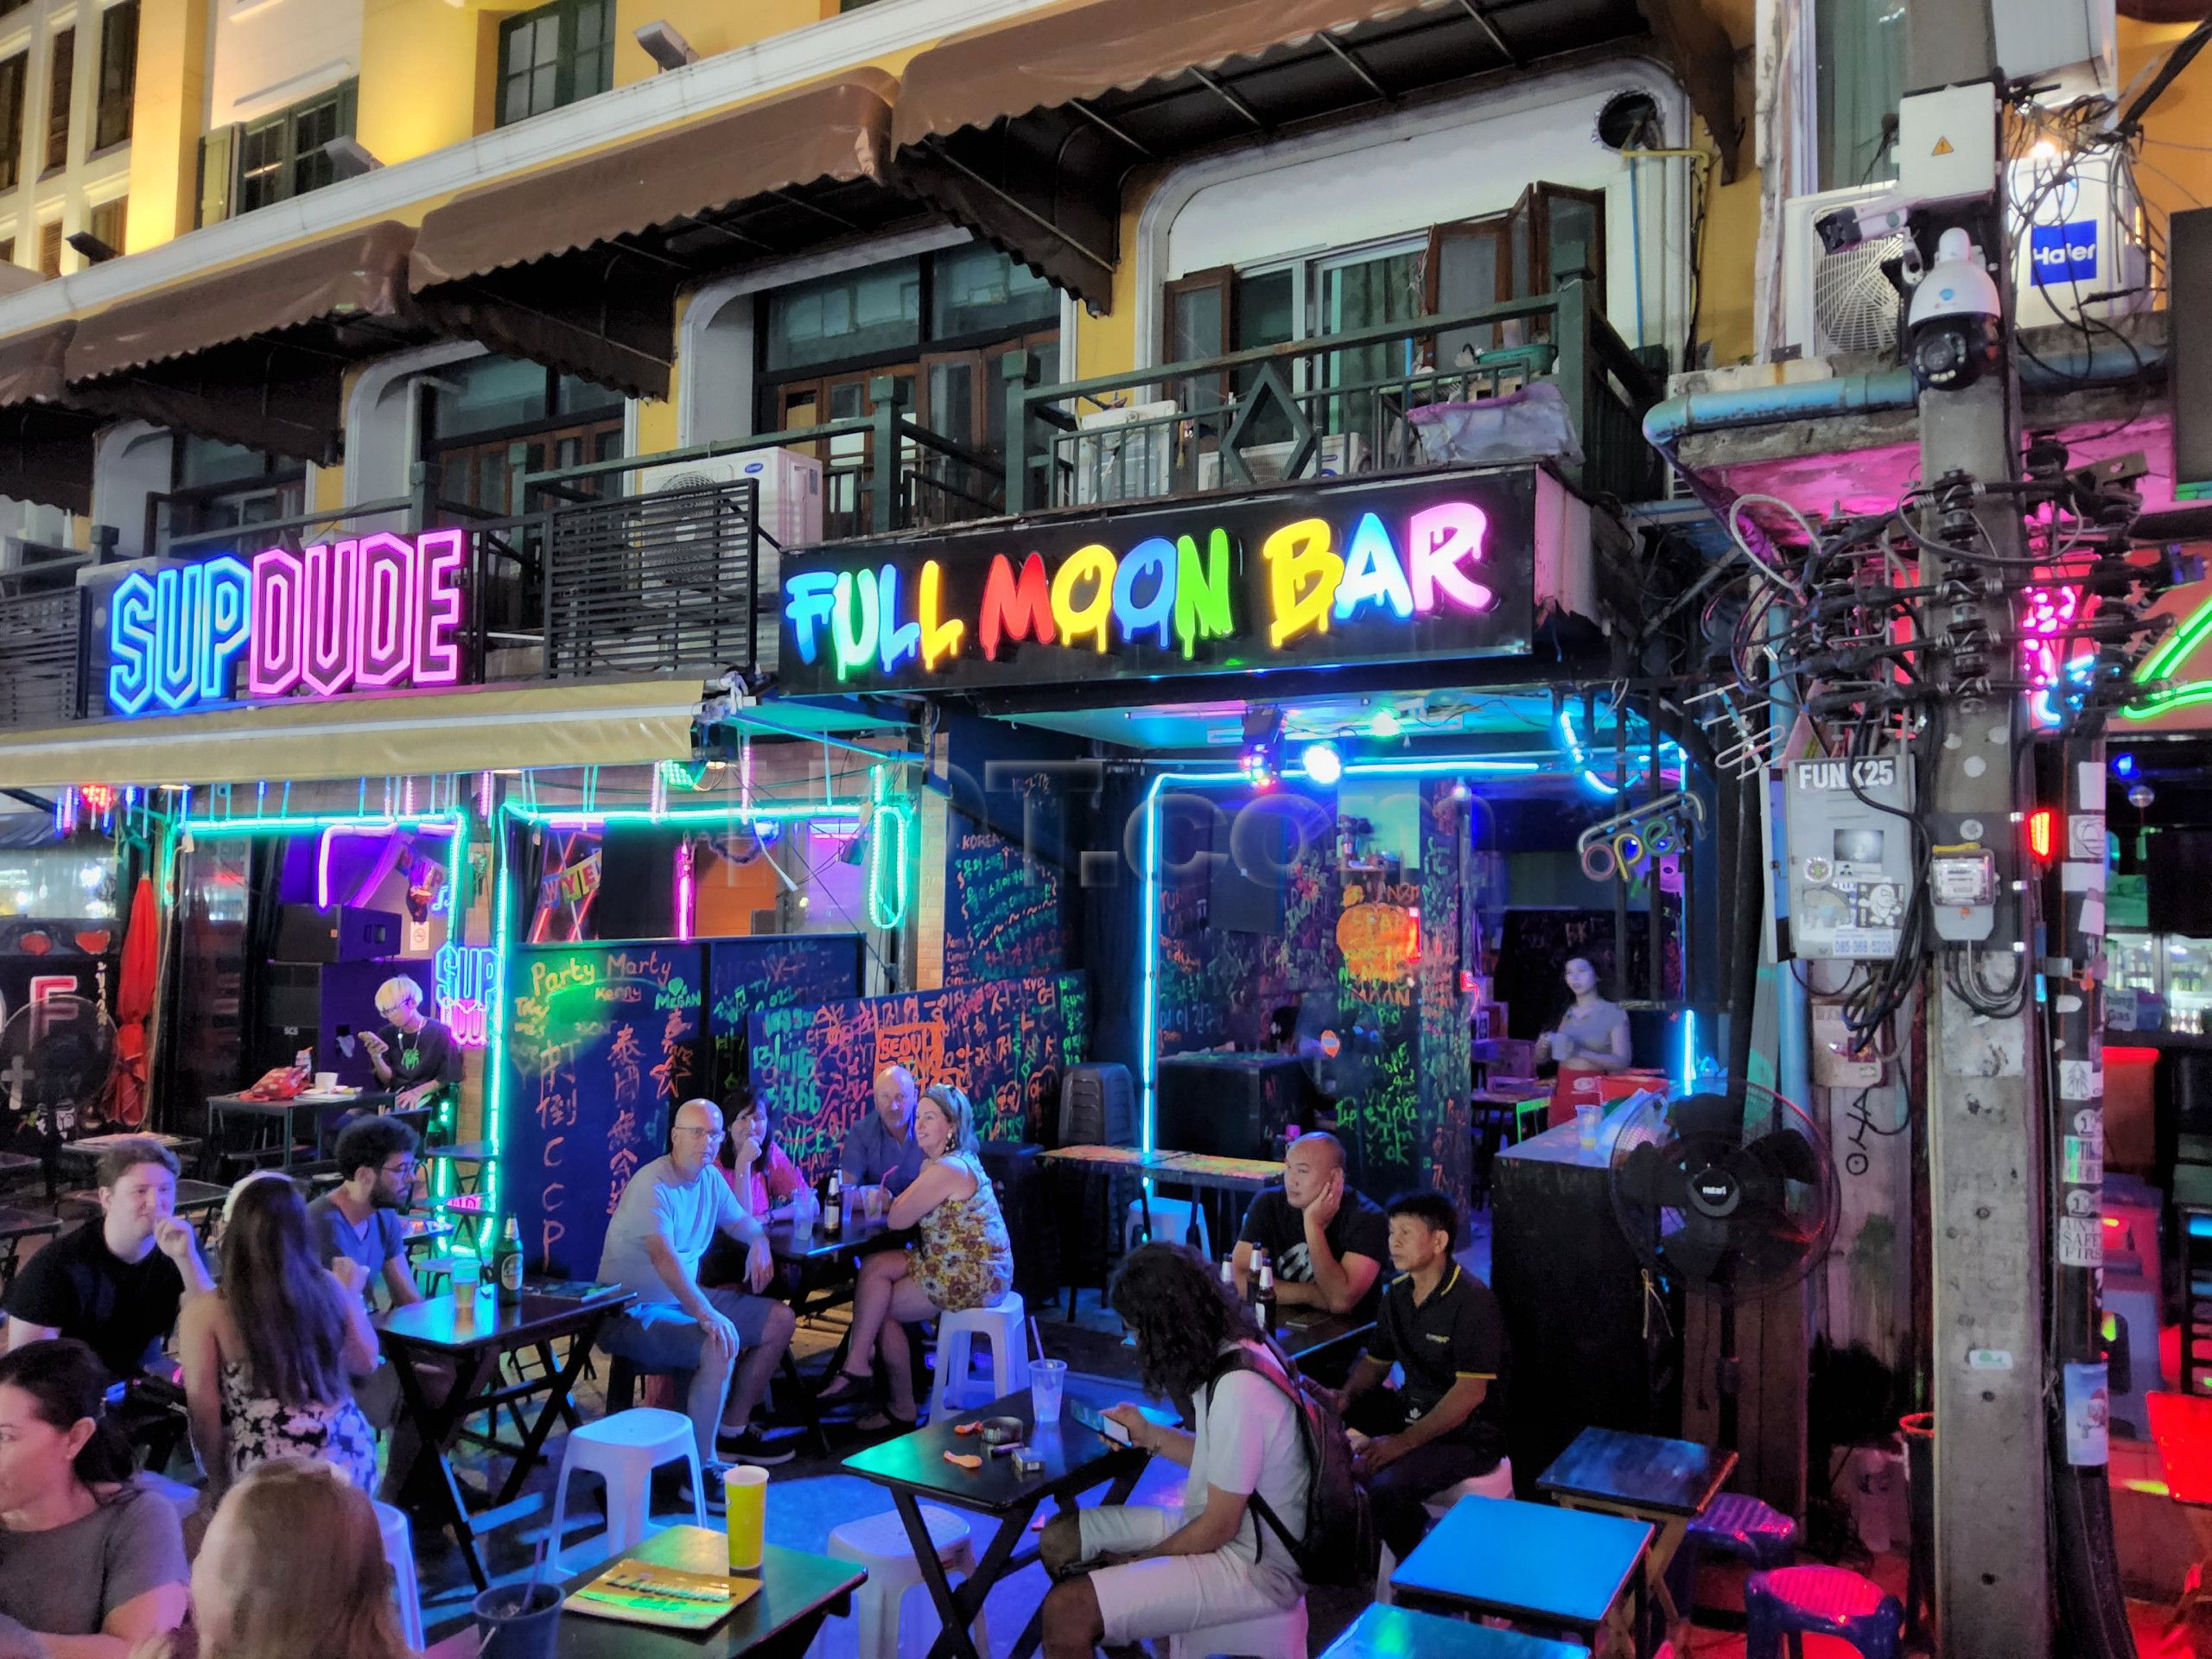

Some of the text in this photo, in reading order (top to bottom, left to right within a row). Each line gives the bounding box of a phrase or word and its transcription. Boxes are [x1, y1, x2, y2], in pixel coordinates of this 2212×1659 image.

[2033, 242, 2096, 265] Haier
[785, 500, 1495, 683] FULL MOON BAR
[531, 950, 672, 997] Party Marty
